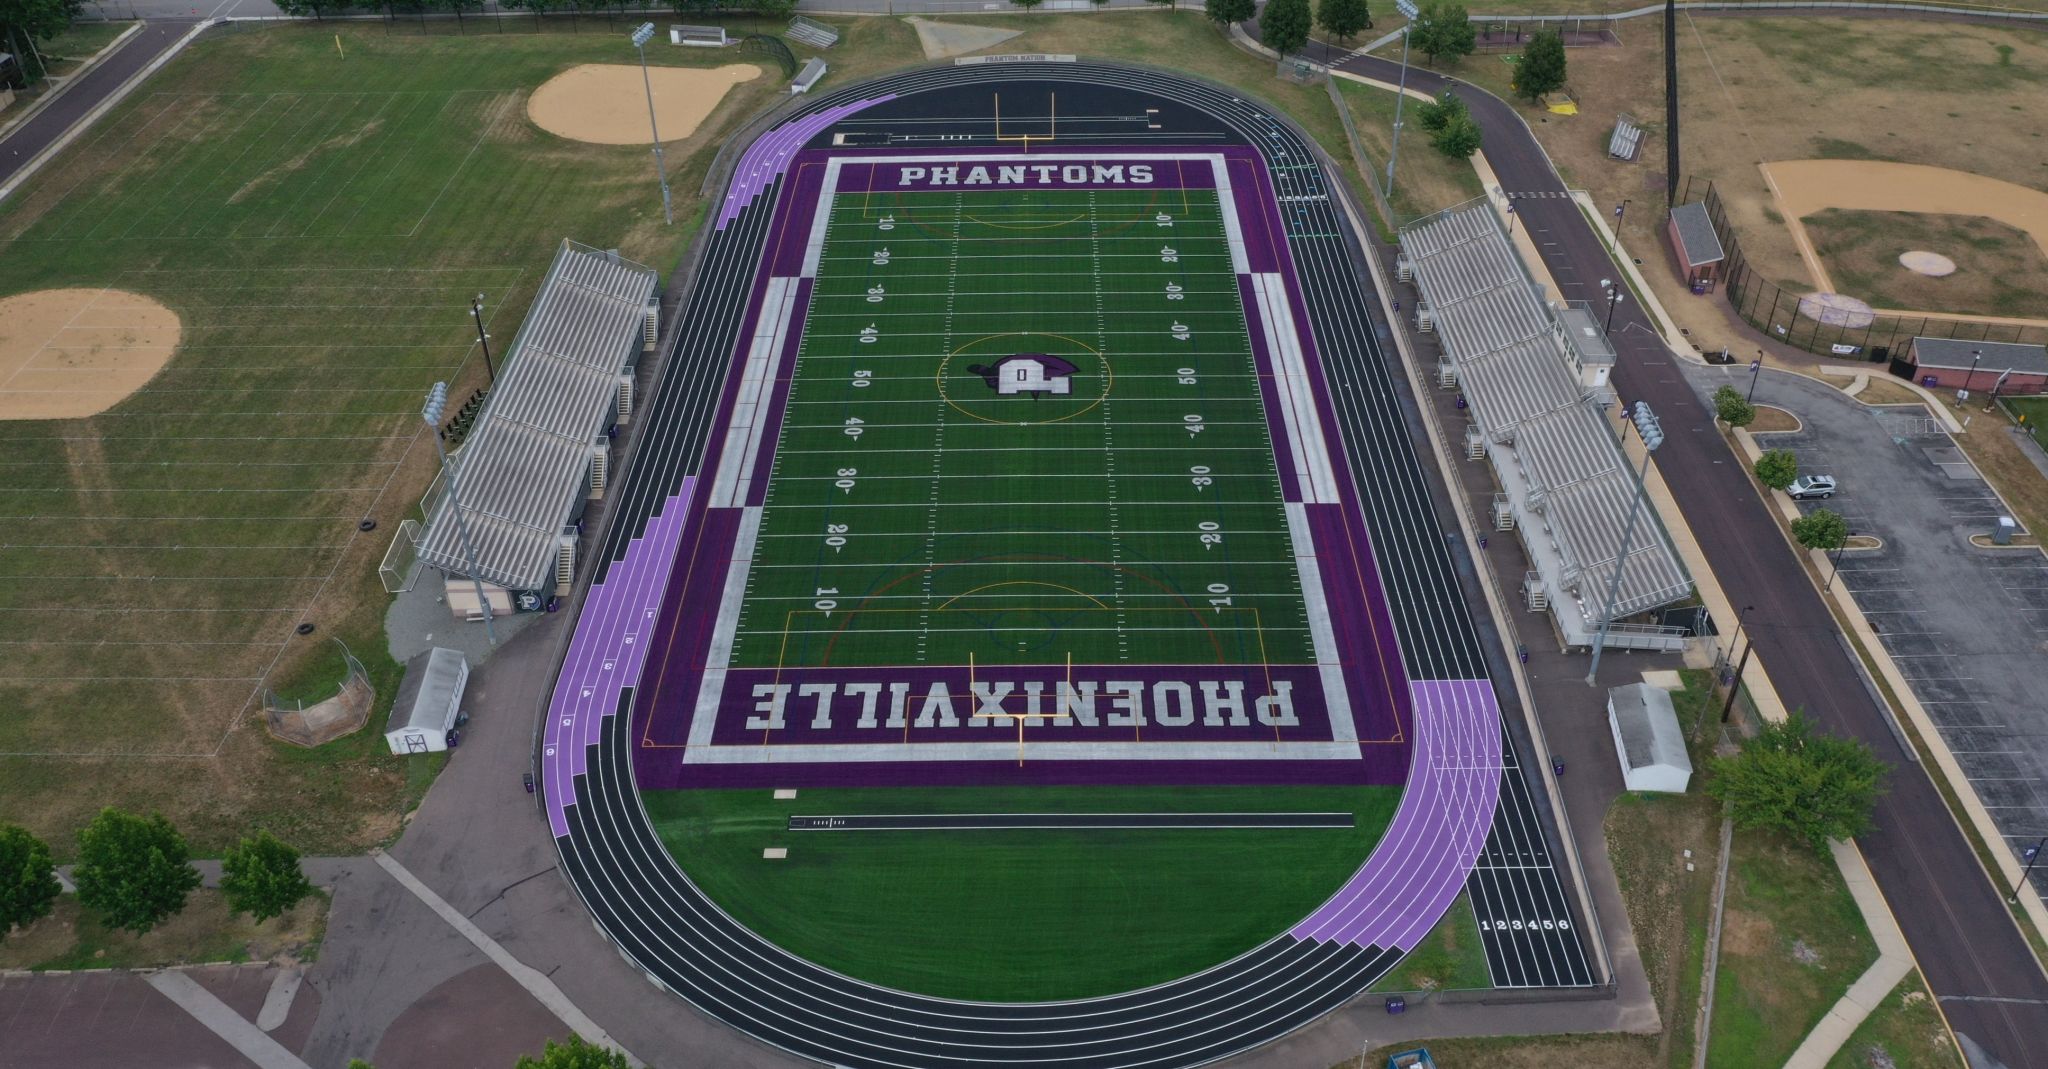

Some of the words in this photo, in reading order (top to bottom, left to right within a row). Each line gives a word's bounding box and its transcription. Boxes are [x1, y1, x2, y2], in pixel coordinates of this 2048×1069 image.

[985, 55, 1019, 63] PHANTOM
[898, 165, 1154, 186] PHANTOMS
[879, 218, 895, 230] 10
[1156, 215, 1173, 227] 10
[873, 251, 890, 265] 20
[1160, 249, 1178, 262] 20
[866, 288, 885, 302] 30
[1165, 285, 1184, 300] 30
[859, 327, 878, 343] 40
[1171, 324, 1190, 340] 40
[852, 370, 872, 387] 50
[1177, 368, 1197, 384] 50
[844, 417, 865, 435] 40
[1183, 414, 1204, 432] 40
[835, 468, 857, 488] 30
[1190, 466, 1212, 485] 30
[825, 524, 848, 546] 20
[1198, 522, 1222, 543] 20
[521, 596, 536, 608] P
[814, 587, 839, 609] 10
[1207, 583, 1231, 605] 10
[625, 637, 634, 645] 2
[583, 690, 591, 698] 4
[745, 681, 1300, 730] PHOENIXVILLE
[562, 719, 571, 727] 5
[546, 748, 555, 756] 6
[1481, 920, 1490, 930] 1
[1496, 920, 1507, 930] 2
[1511, 920, 1523, 930] 3
[1527, 920, 1539, 930] 4
[1542, 920, 1554, 930] 5
[1558, 920, 1569, 930] 6
